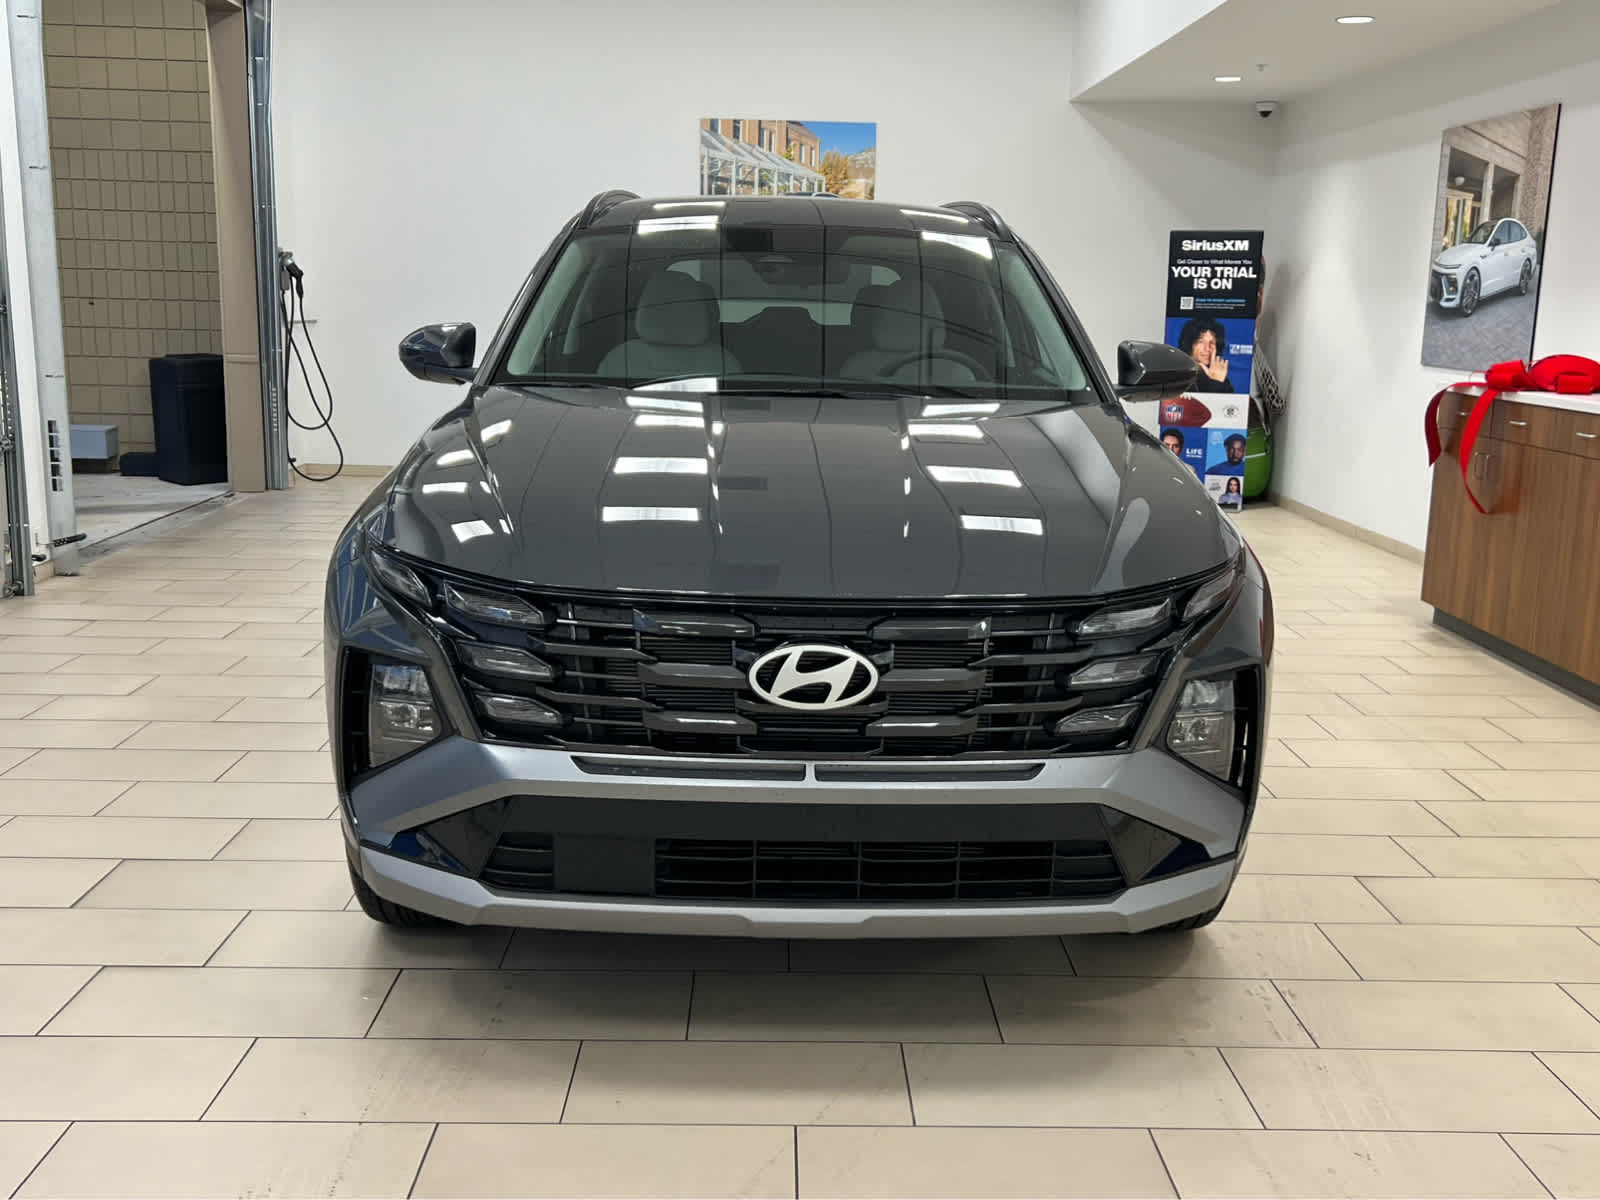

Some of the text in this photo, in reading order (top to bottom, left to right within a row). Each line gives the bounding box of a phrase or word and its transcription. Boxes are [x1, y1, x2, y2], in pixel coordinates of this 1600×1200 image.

[1182, 240, 1249, 251] SiriusXM
[1172, 266, 1256, 278] YOUR TRIAL
[1193, 278, 1232, 290] IS ON
